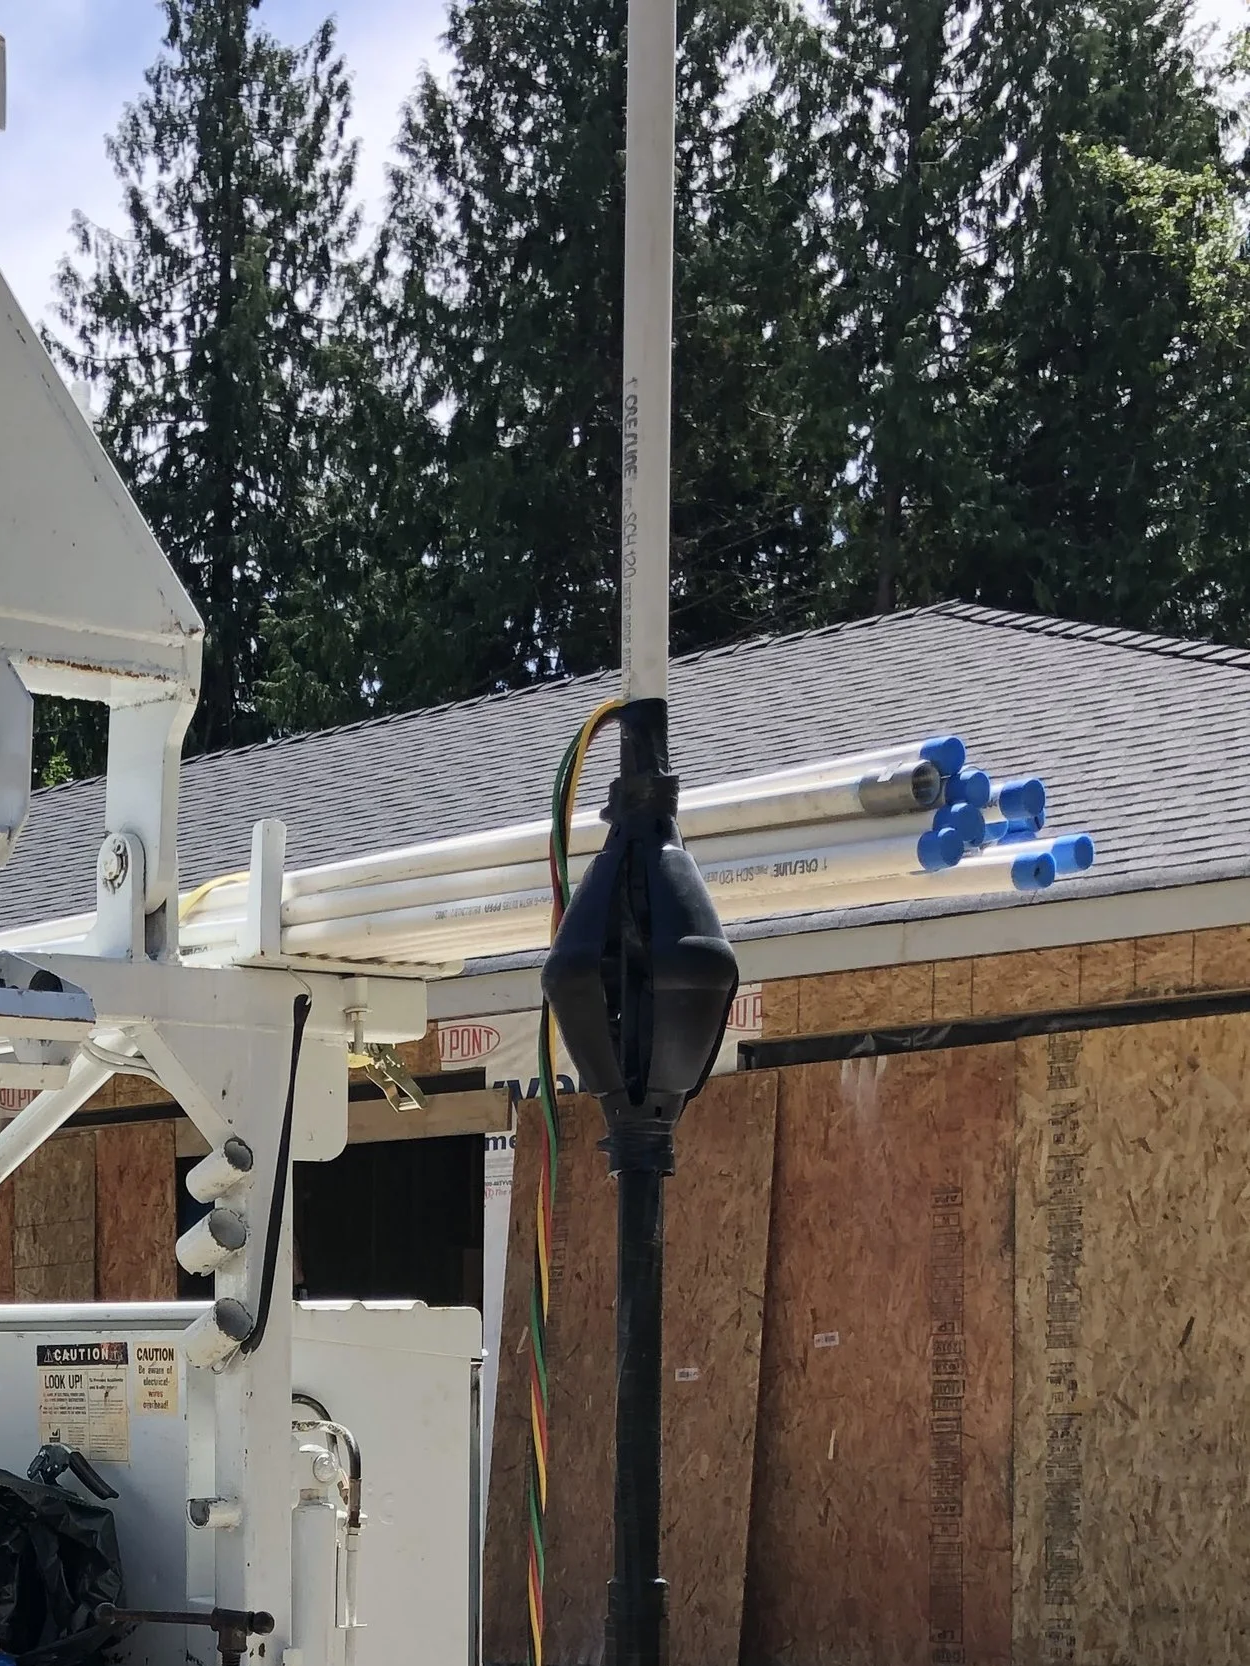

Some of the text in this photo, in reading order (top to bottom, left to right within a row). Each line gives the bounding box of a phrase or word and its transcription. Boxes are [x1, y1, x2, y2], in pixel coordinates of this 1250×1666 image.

[623, 511, 638, 547] SCH
[623, 547, 637, 579] 120
[719, 869, 734, 885] 120
[736, 866, 754, 882] SCH
[54, 1347, 109, 1362] CAUTION
[136, 1347, 175, 1361] CAUTION
[44, 1374, 83, 1389] LOOK UP!
